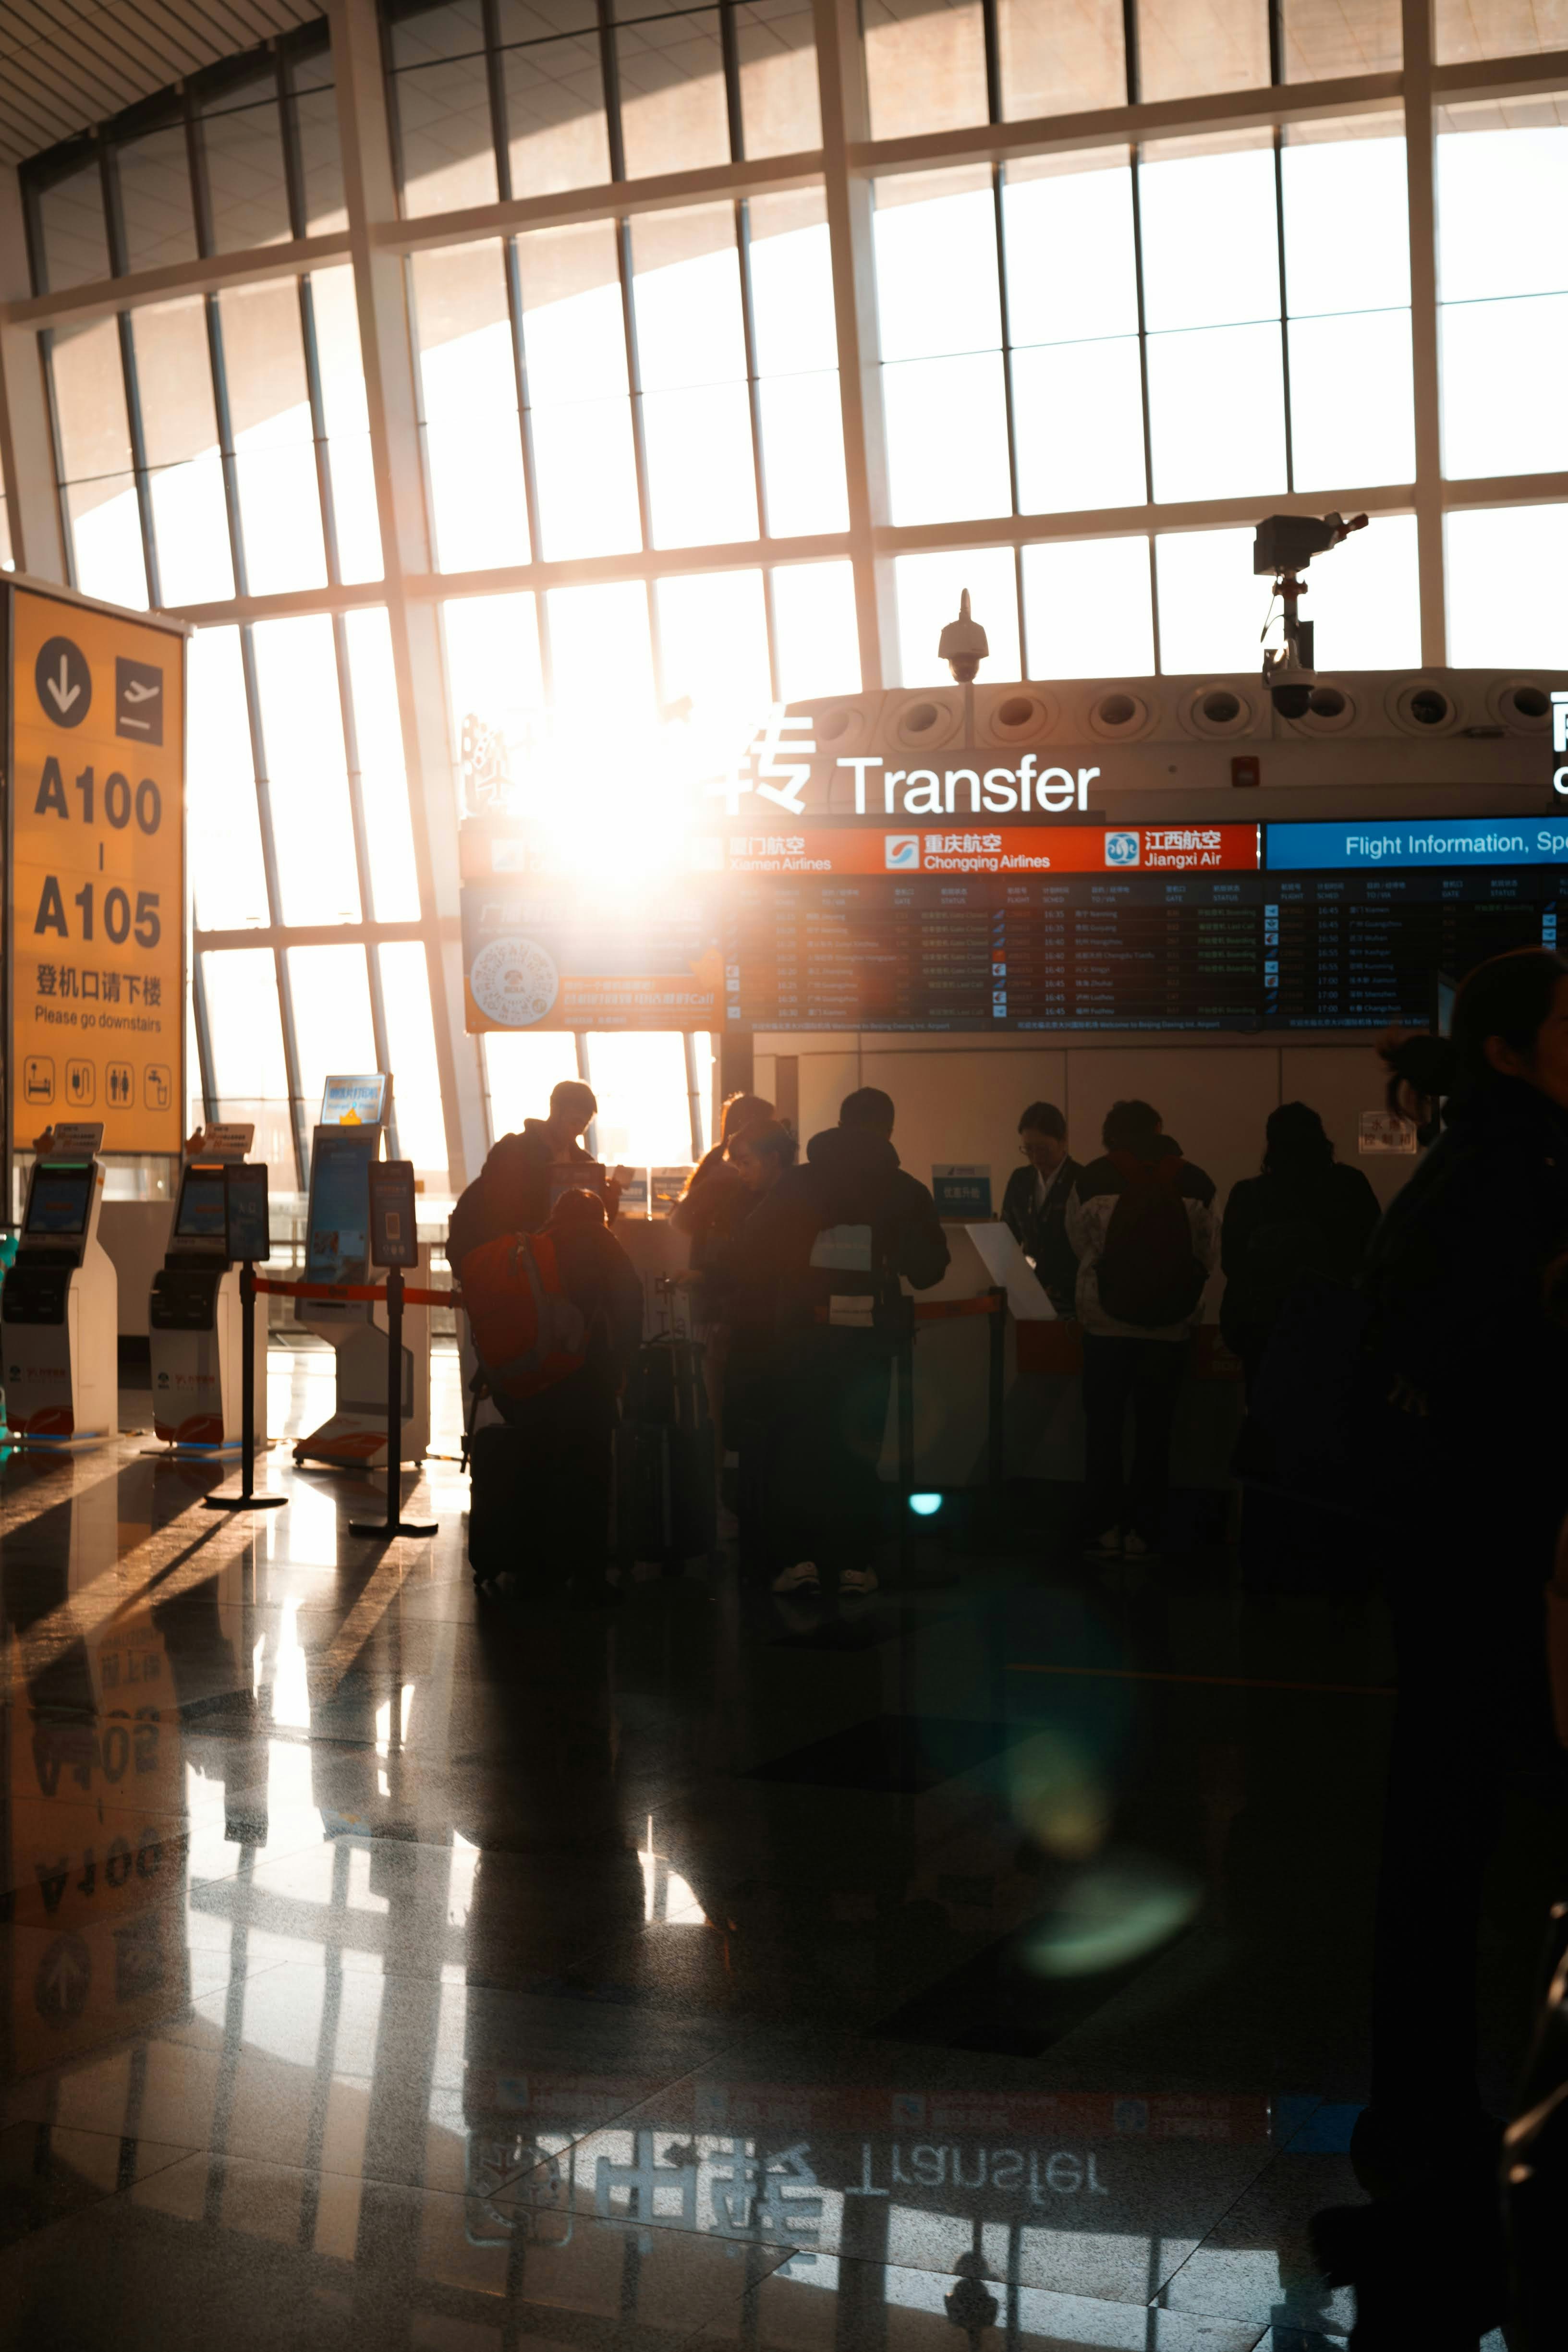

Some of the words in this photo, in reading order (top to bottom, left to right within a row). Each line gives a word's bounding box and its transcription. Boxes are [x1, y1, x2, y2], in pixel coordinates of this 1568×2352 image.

[34, 756, 161, 836] A100
[837, 754, 1100, 815] Transfer
[730, 836, 805, 856] 厦门航空
[924, 833, 1001, 853] 重庆航空
[1145, 830, 1221, 851] 江西航空
[1346, 836, 1402, 861] Flight
[1409, 833, 1529, 854] Information,
[1537, 831, 1568, 855] Sp
[730, 858, 781, 871] Xiamen
[782, 857, 831, 870] Airlines
[924, 855, 998, 872] Chongqing
[1000, 854, 1050, 868] Airlines
[1145, 852, 1197, 869] Jiangxi
[1200, 852, 1221, 866] Air
[34, 875, 160, 948] A105
[37, 964, 161, 1007] 登机口请下楼
[36, 1005, 77, 1026] Please
[80, 1013, 96, 1030] go
[99, 1012, 161, 1032] downstairs
